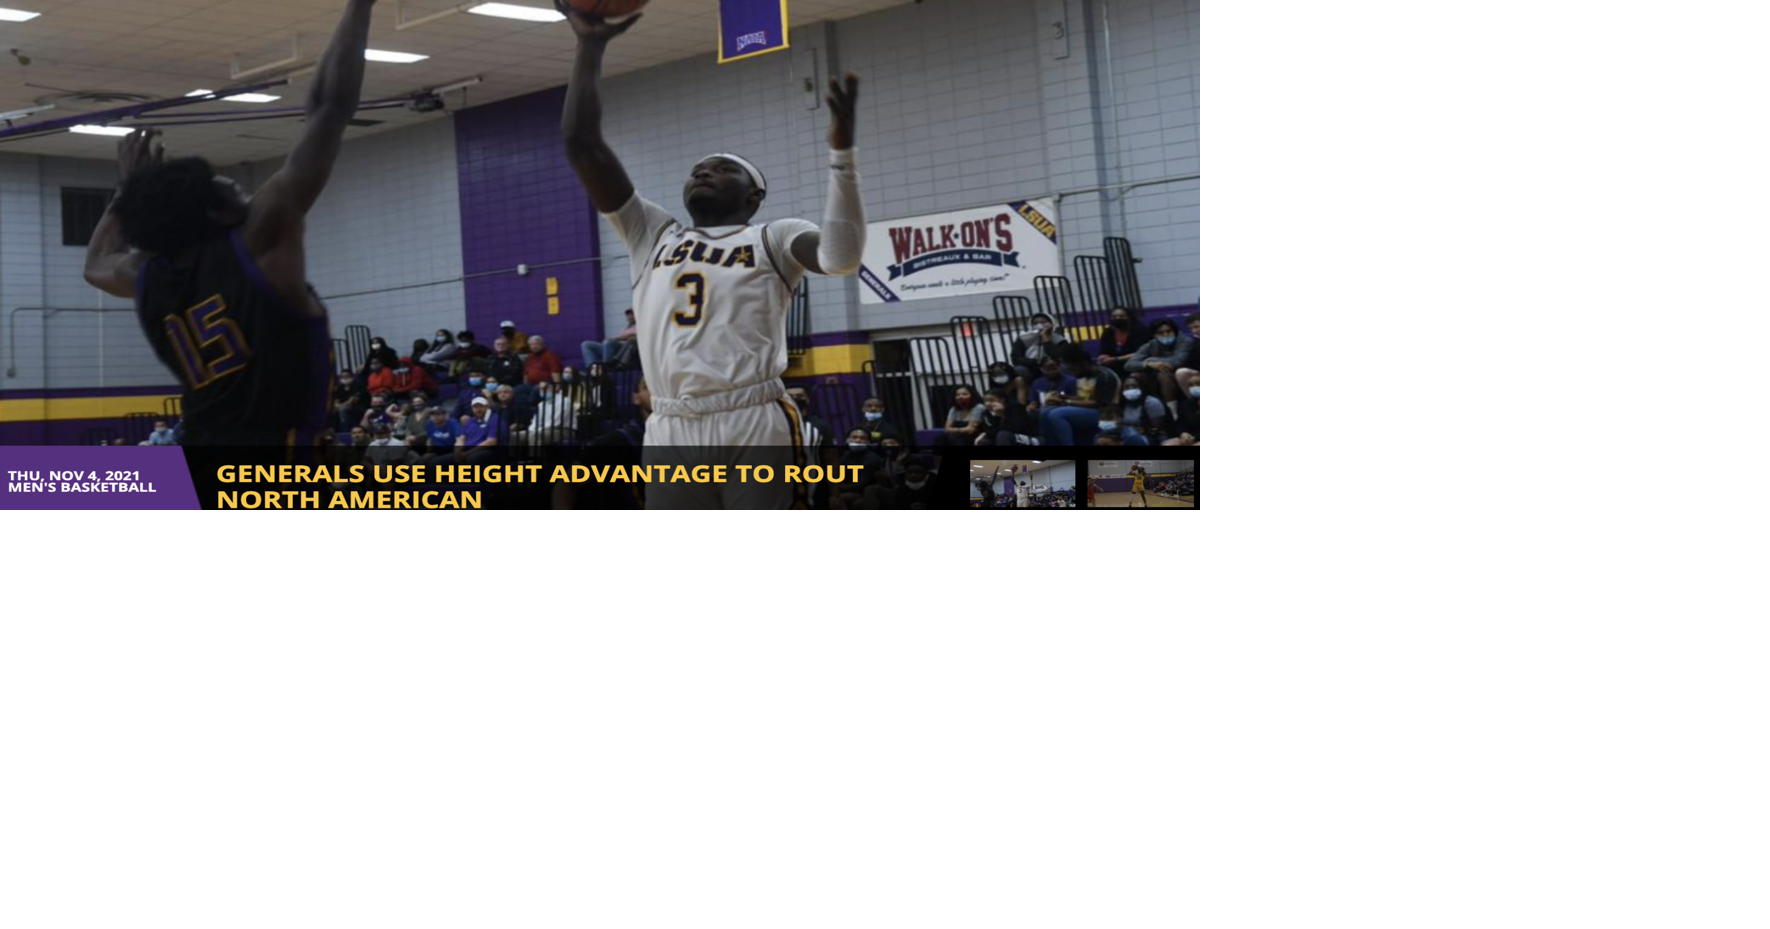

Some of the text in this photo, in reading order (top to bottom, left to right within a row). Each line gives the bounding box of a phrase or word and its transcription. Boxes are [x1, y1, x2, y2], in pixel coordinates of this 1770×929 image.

[1018, 204, 1056, 238] LSUA
[652, 239, 756, 270] LSUA
[913, 253, 960, 269] BISTREAUX
[672, 270, 706, 328] 3
[861, 270, 891, 300] GENERALS
[164, 293, 252, 390] 15
